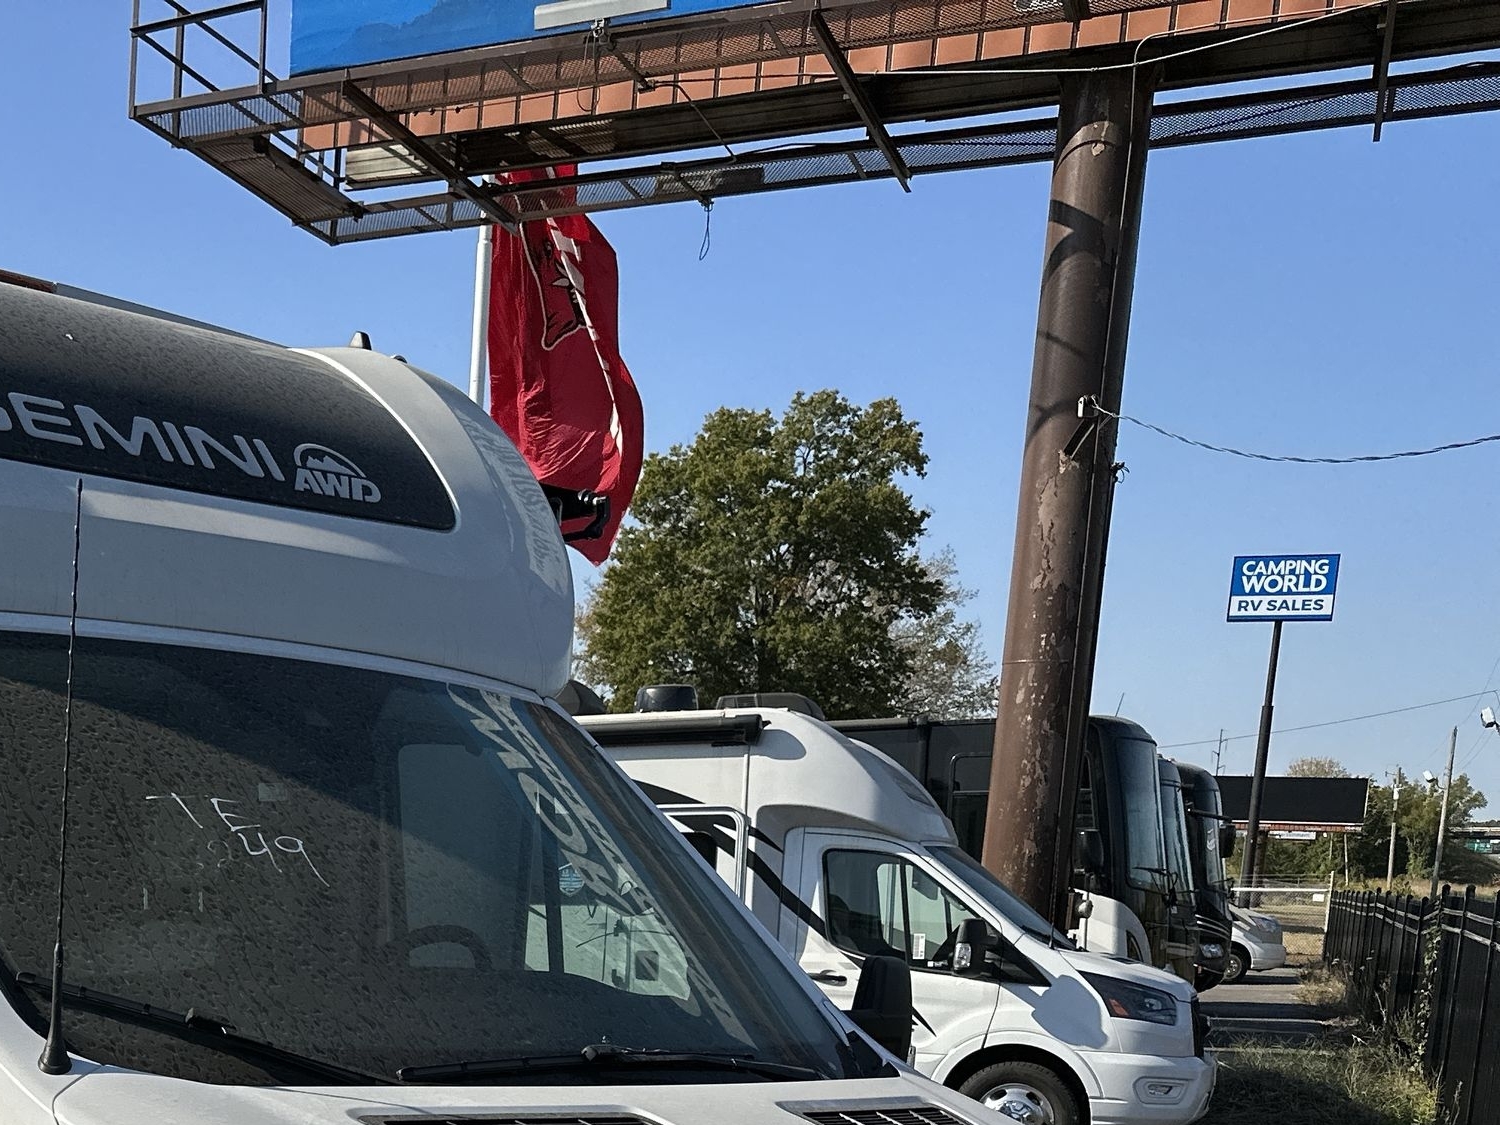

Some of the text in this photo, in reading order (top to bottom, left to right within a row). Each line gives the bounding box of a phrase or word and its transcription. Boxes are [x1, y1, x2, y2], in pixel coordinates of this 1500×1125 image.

[294, 468, 382, 503] AWD
[1242, 559, 1329, 575] CAMPING
[1242, 575, 1327, 593] WORLD
[1238, 599, 1324, 612] RV SALES
